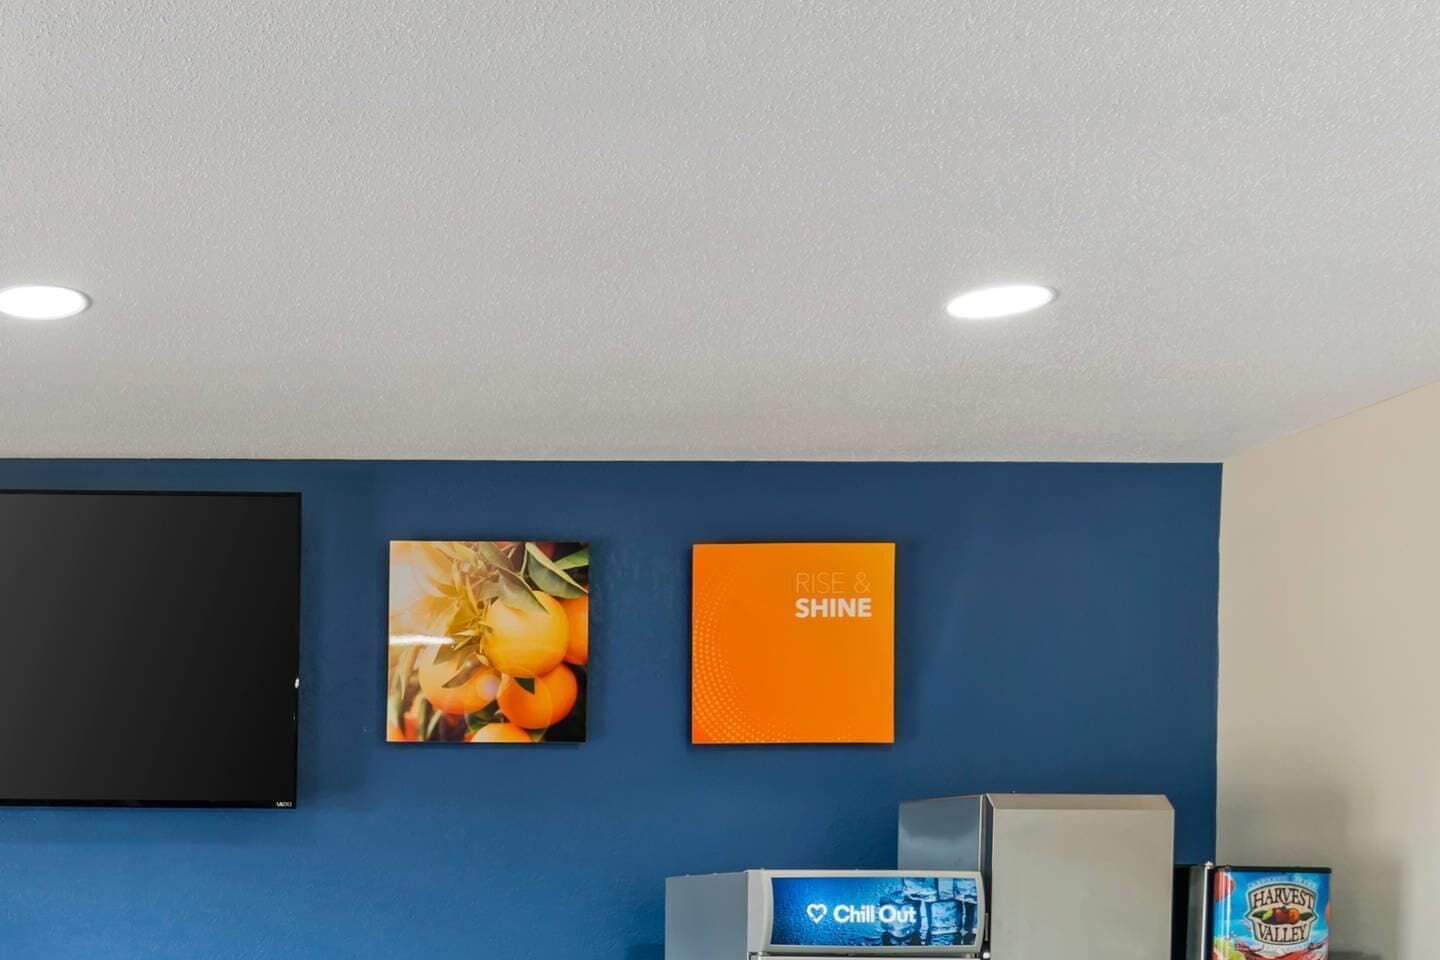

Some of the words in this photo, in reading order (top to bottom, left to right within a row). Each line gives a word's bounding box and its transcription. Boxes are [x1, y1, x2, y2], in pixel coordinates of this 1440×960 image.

[796, 572, 846, 594] RISE
[854, 572, 871, 594] &
[795, 597, 872, 618] SHINE
[1253, 887, 1315, 911] HARVEST
[834, 904, 875, 924] Chill
[879, 904, 916, 924] Out
[1257, 923, 1308, 942] VALLEY
